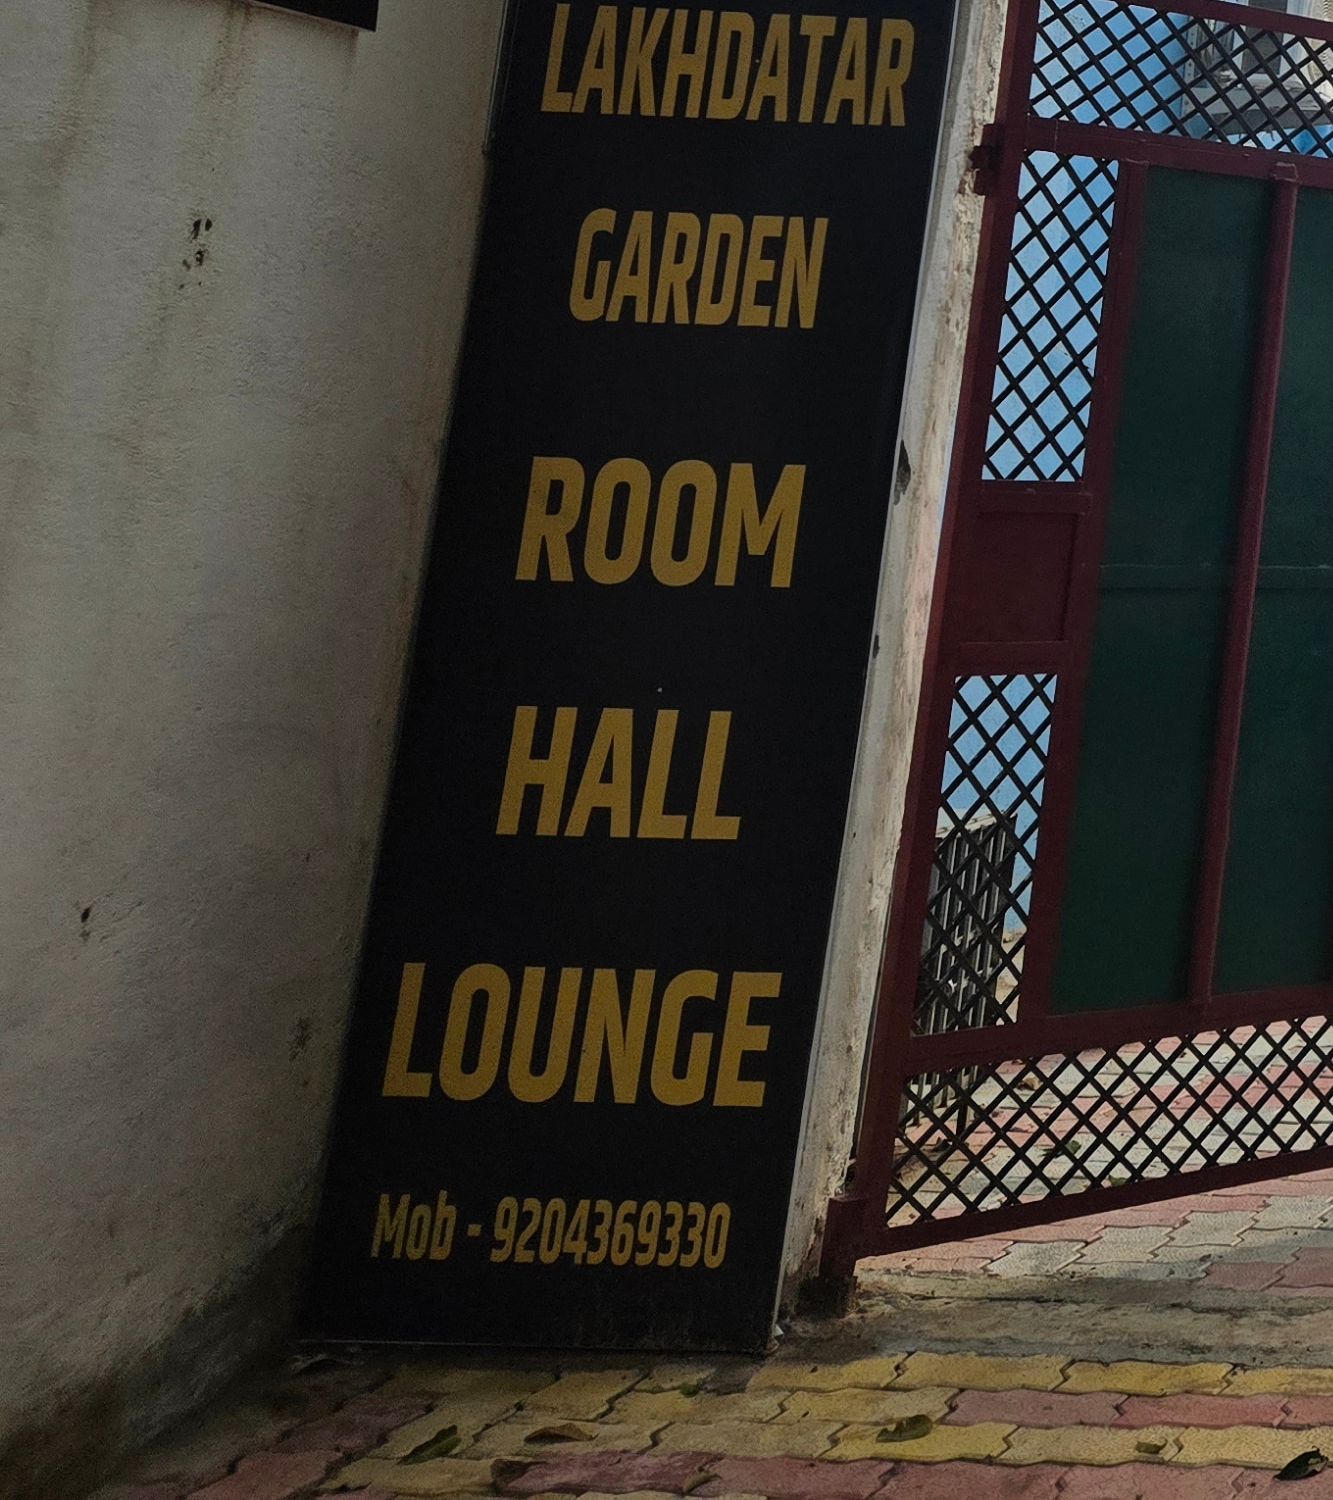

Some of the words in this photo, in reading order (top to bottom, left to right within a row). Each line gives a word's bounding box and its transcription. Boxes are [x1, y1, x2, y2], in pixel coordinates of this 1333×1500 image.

[540, 3, 915, 126] LAKHDATAR
[568, 208, 830, 329] GARDEN
[515, 456, 807, 588] ROOM
[496, 706, 742, 840] HALL
[381, 962, 783, 1107] LOUNGE
[371, 1190, 457, 1260] Mob
[468, 1224, 479, 1238] -
[490, 1196, 732, 1269] 9204369330
